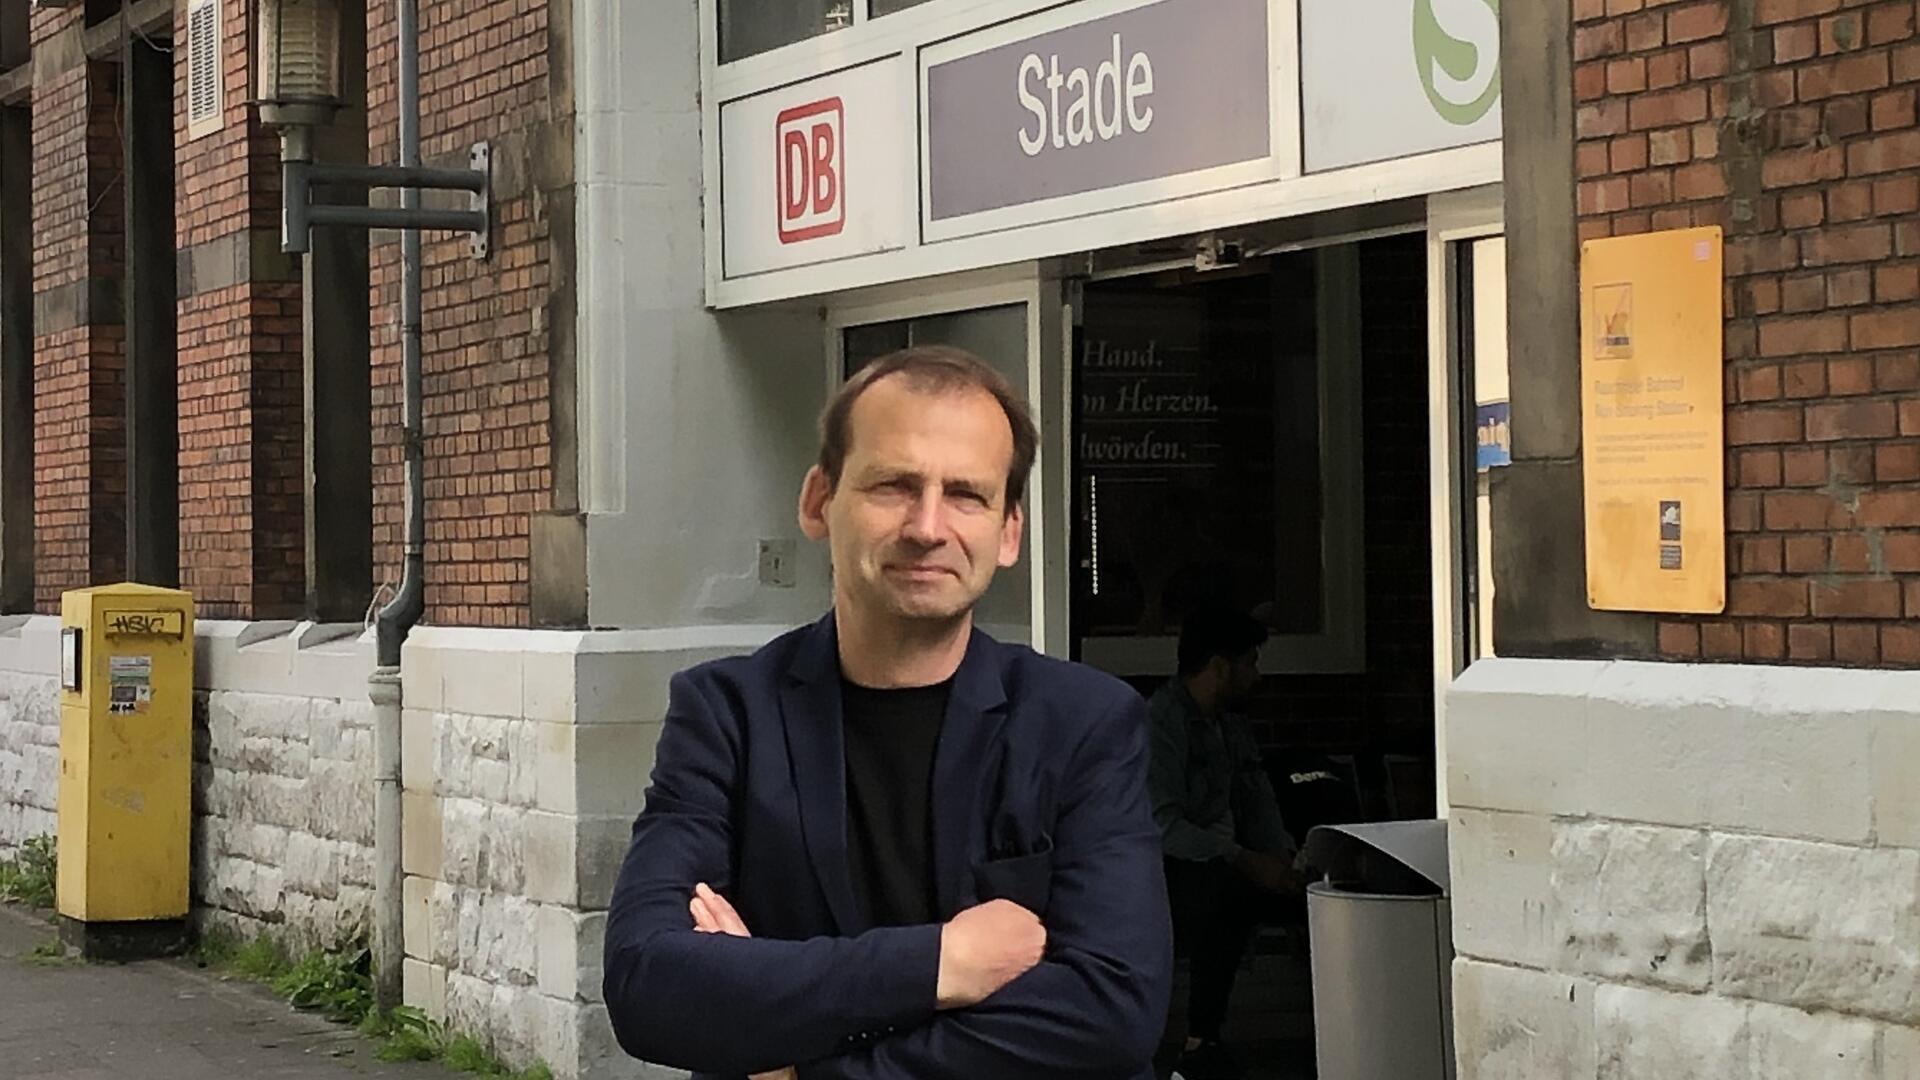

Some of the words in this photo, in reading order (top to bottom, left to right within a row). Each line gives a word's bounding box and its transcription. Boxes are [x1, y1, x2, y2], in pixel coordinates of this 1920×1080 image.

[1018, 32, 1154, 157] Stade
[784, 121, 837, 221] DB
[1082, 340, 1163, 367] Hand.
[1115, 378, 1219, 413] Herzen.
